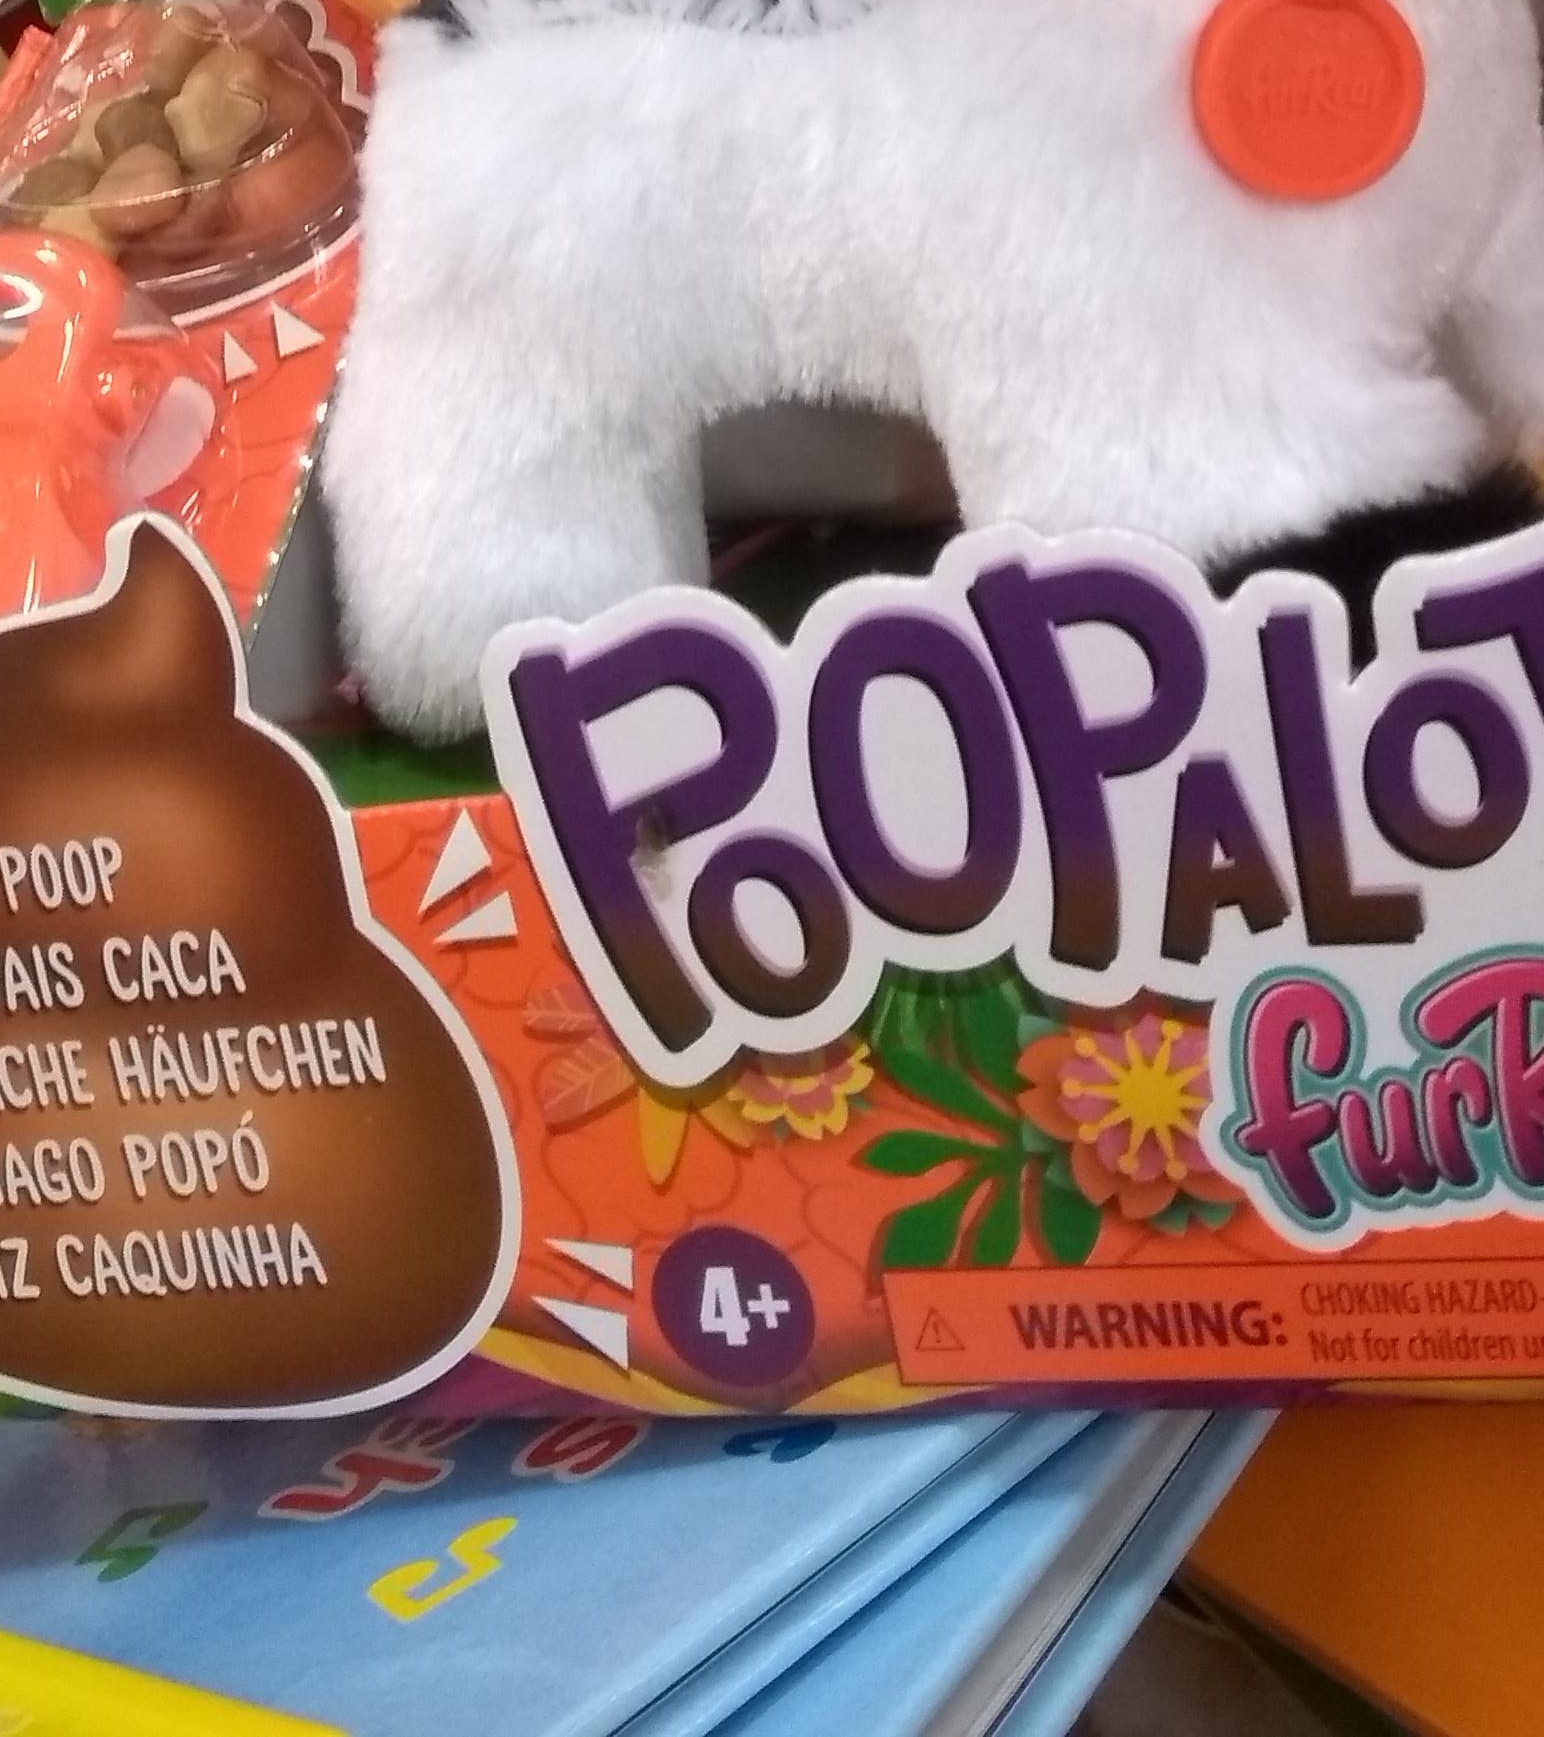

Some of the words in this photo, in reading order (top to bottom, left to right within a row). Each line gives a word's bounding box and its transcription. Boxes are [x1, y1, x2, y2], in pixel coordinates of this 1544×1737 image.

[102, 927, 248, 1004] CACA
[108, 1016, 389, 1104] HÄUFCHEN
[122, 1109, 271, 1200] POPÓ
[55, 1221, 329, 1298] CAQUINHA
[1299, 1279, 1422, 1317] CHOKING
[700, 1266, 791, 1347] 4+
[1007, 1298, 1289, 1352] WARNING:
[1307, 1328, 1356, 1363] Not
[1361, 1327, 1400, 1361] for
[1406, 1325, 1518, 1362] children
